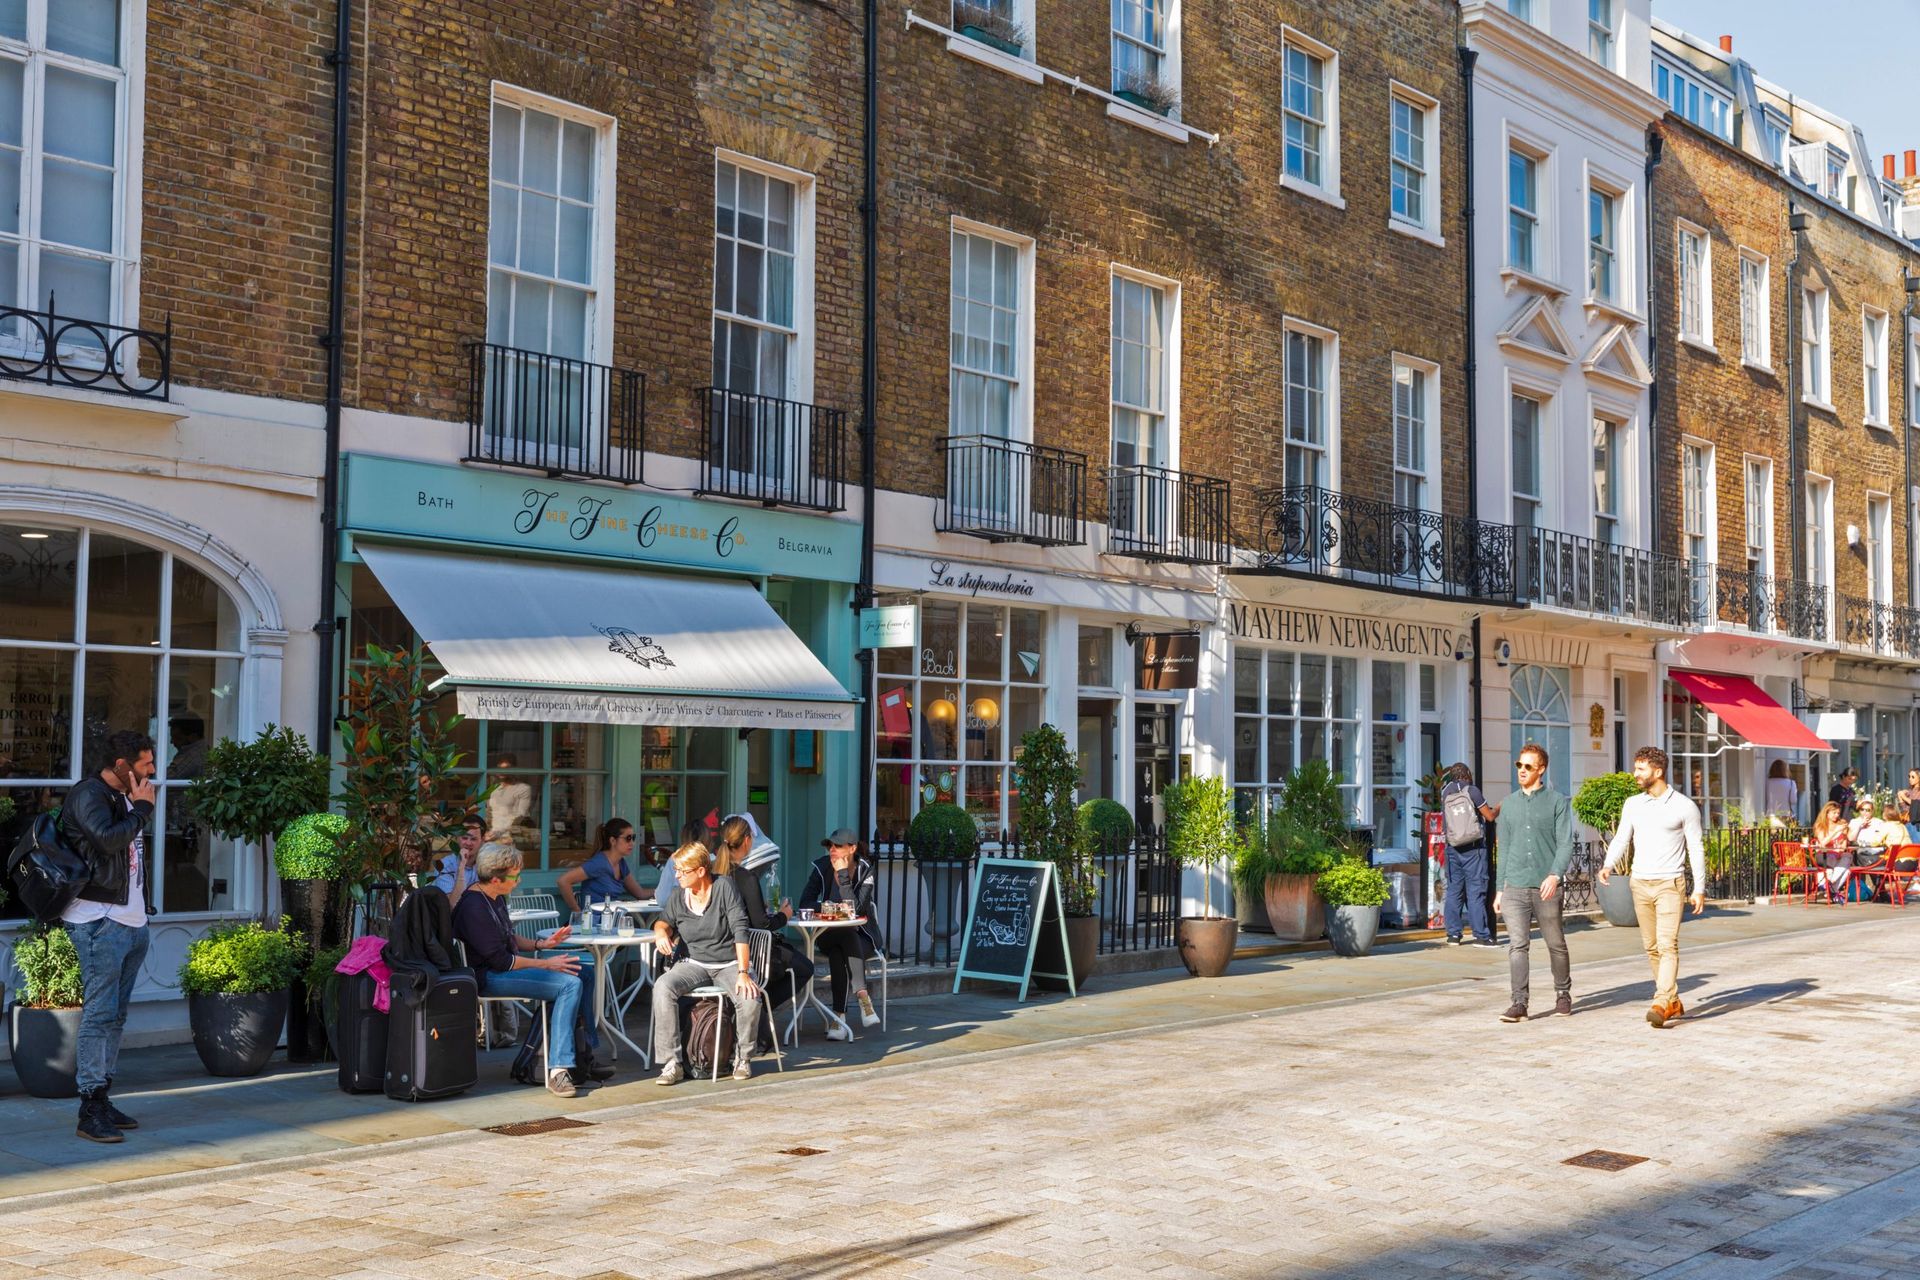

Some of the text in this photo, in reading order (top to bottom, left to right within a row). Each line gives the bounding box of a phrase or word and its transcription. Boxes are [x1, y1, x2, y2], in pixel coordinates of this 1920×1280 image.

[418, 491, 454, 509] BATH
[778, 537, 833, 556] BELGRAVIA
[929, 560, 1035, 598] La stupenderia
[1229, 603, 1453, 658] MAYHEW NEWSAGENTS
[922, 648, 957, 675] Back
[477, 695, 510, 709] British
[512, 696, 522, 708] &
[525, 697, 571, 713] European
[574, 700, 605, 712] Artisan
[607, 701, 643, 714] Cheeses
[656, 703, 675, 715] Fine
[677, 704, 703, 716] Wines
[705, 705, 714, 716] &
[717, 705, 764, 718] Charcuterie
[775, 708, 794, 719] Plats
[795, 710, 803, 719] et
